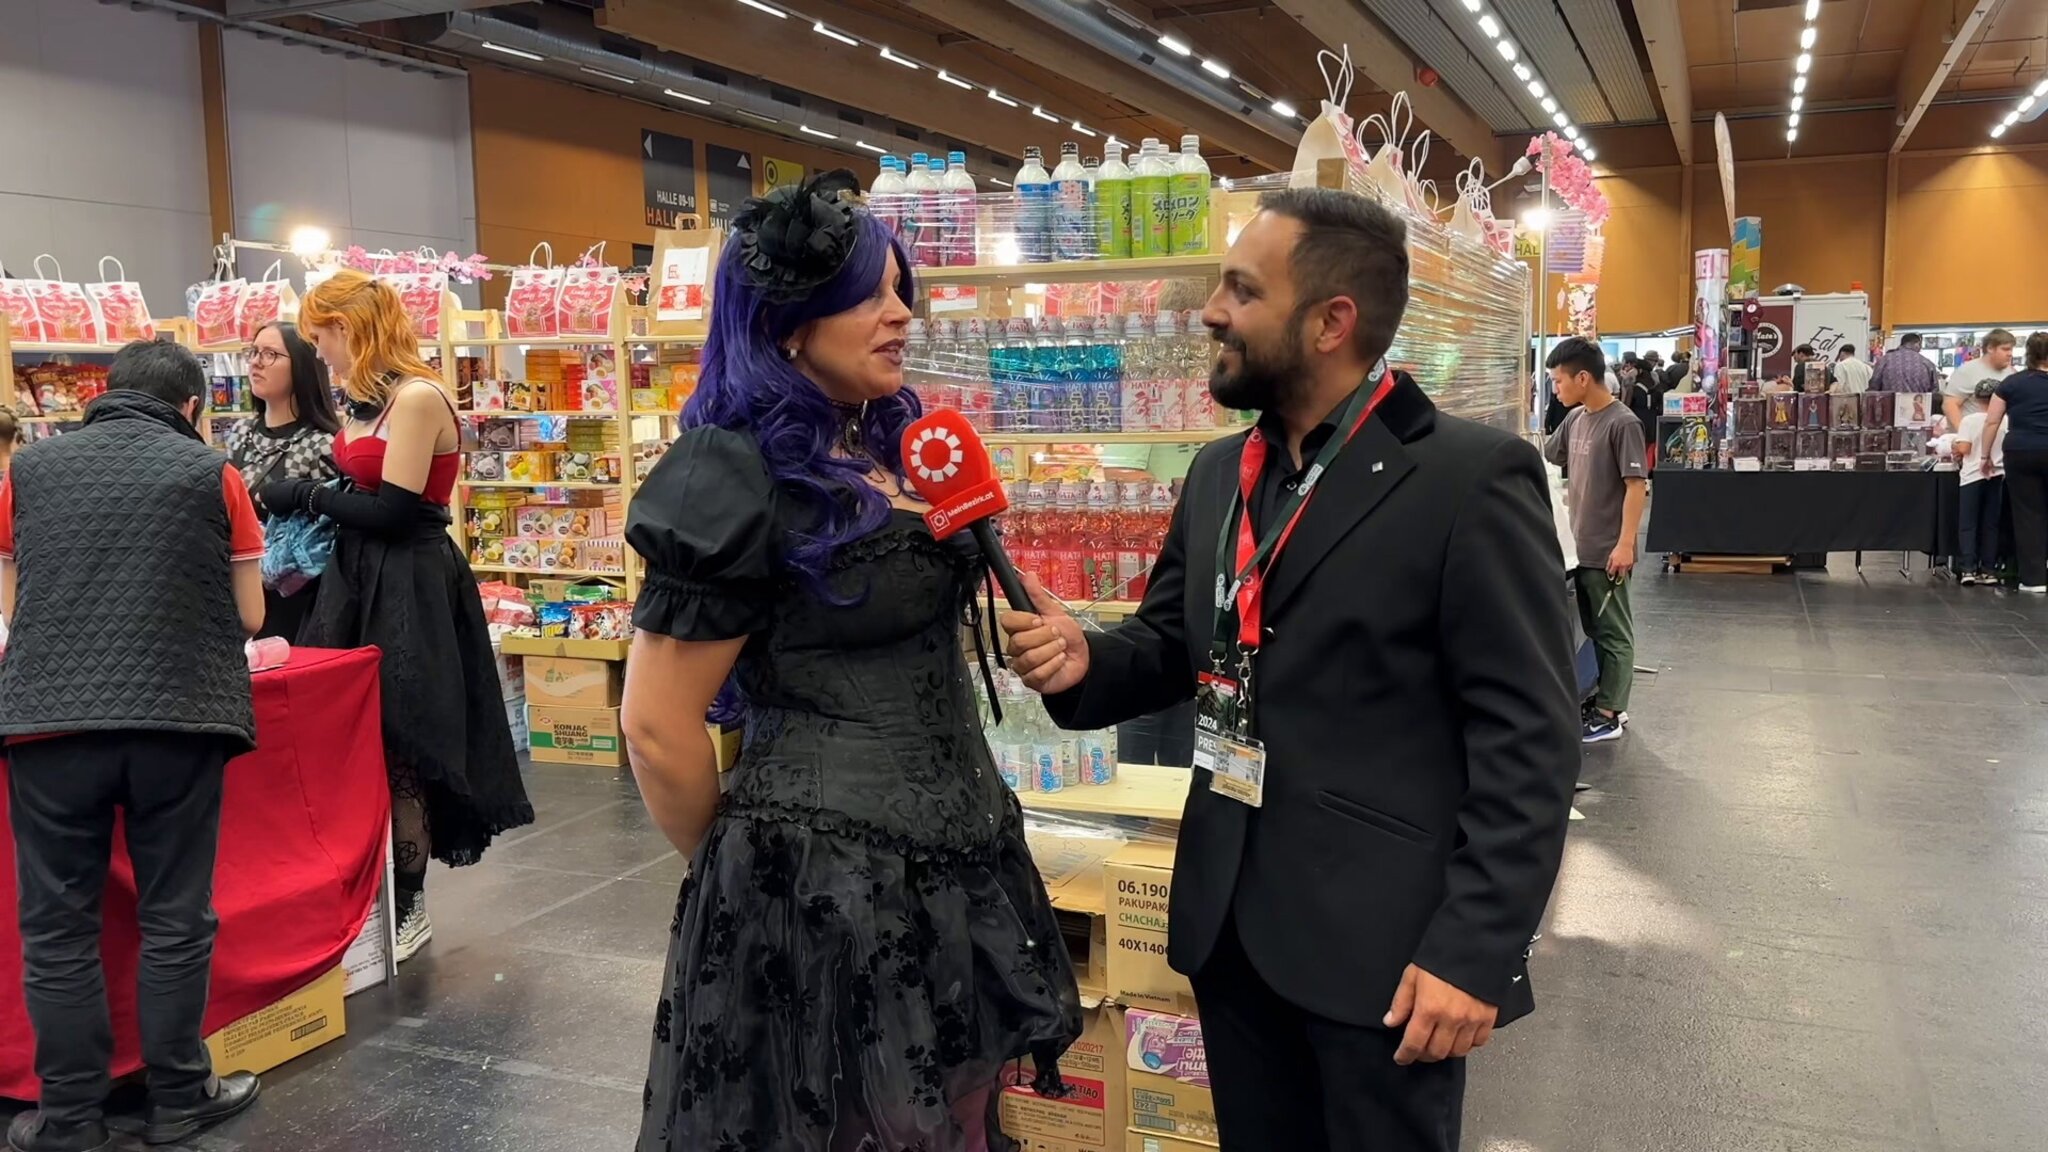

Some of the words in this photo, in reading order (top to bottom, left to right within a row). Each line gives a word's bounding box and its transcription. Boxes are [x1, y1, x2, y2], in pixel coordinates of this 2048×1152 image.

[657, 189, 677, 206] HALLE
[678, 194, 695, 208] 09-10
[646, 207, 676, 228] HALL
[1091, 382, 1115, 391] HATA
[946, 491, 995, 518] MeinBezirk.at
[553, 723, 588, 732] KONJAC
[1198, 714, 1218, 731] 2024
[554, 729, 588, 738] SHUANG
[1117, 879, 1168, 898] 06.190
[1120, 989, 1137, 999] Made
[1145, 994, 1171, 1003] Vietnam
[1079, 1084, 1098, 1099] TIAO
